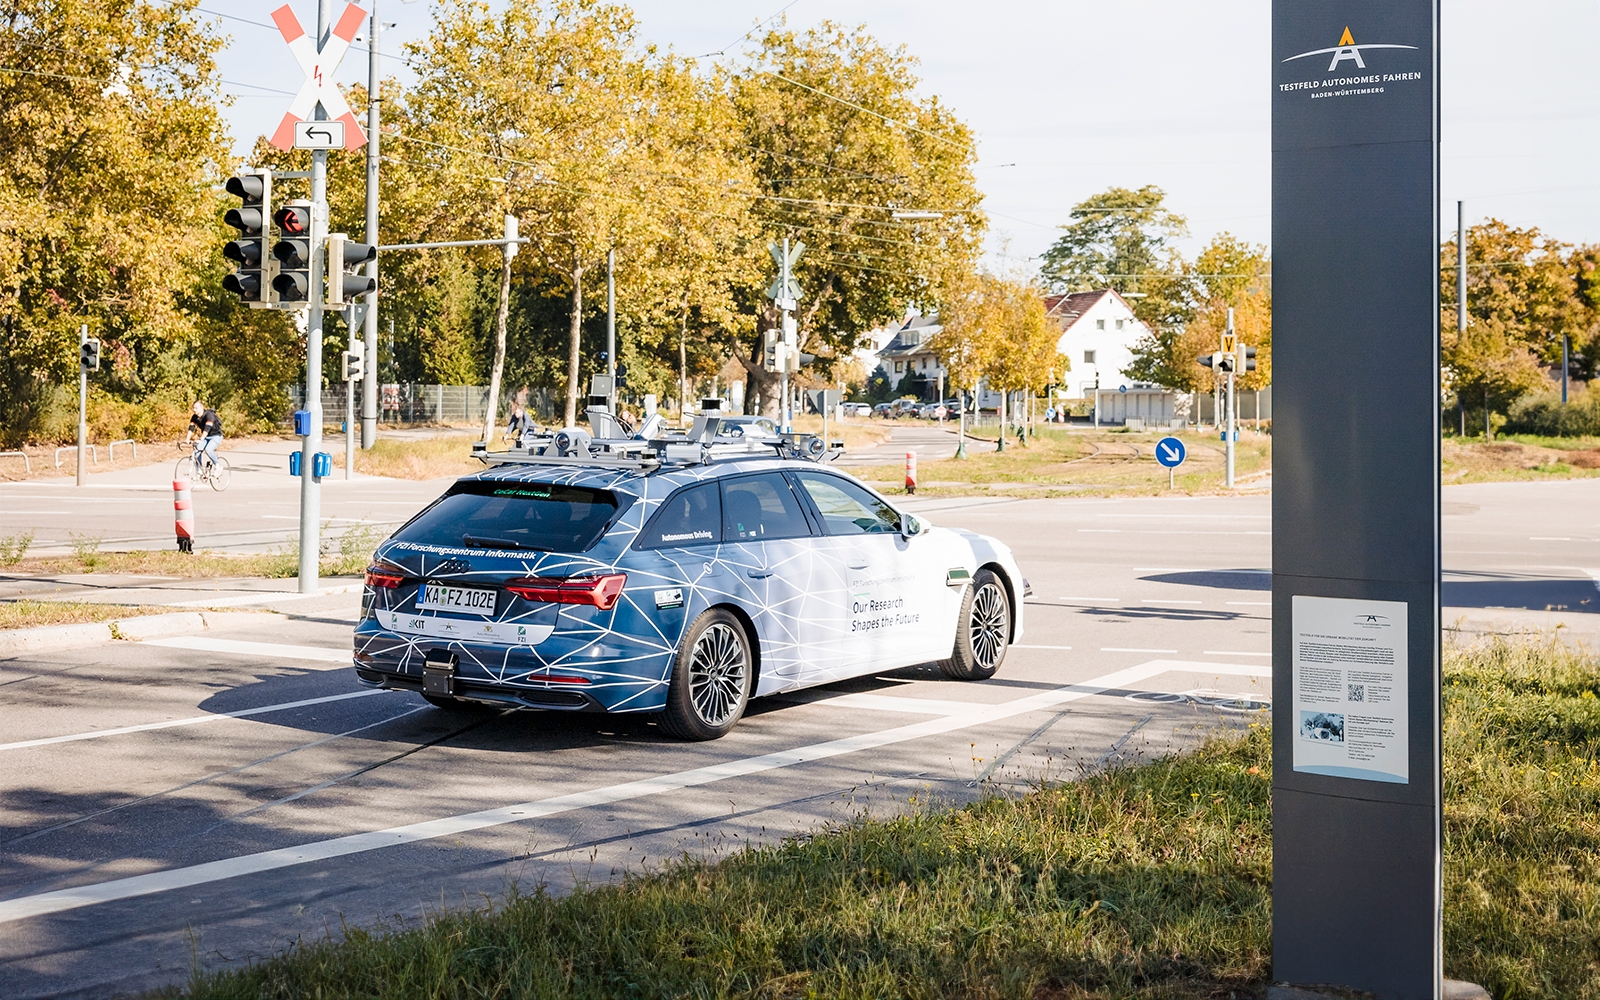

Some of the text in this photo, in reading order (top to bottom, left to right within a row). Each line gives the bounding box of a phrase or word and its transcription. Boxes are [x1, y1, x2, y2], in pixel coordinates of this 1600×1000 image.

[1279, 72, 1421, 92] TESTFELD AUTONOMES FAHREN
[1311, 87, 1385, 99] BADEN-WÜRTTEMBERG
[1225, 337, 1233, 352] V
[661, 530, 713, 542] Autonomous Driving
[409, 544, 485, 557] Forschungszentrum
[486, 550, 537, 560] Informatik
[424, 587, 496, 609] KA FZ 102E
[853, 596, 904, 614] Our Research
[413, 619, 425, 629] KIT
[852, 613, 920, 633] Shapes the Future
